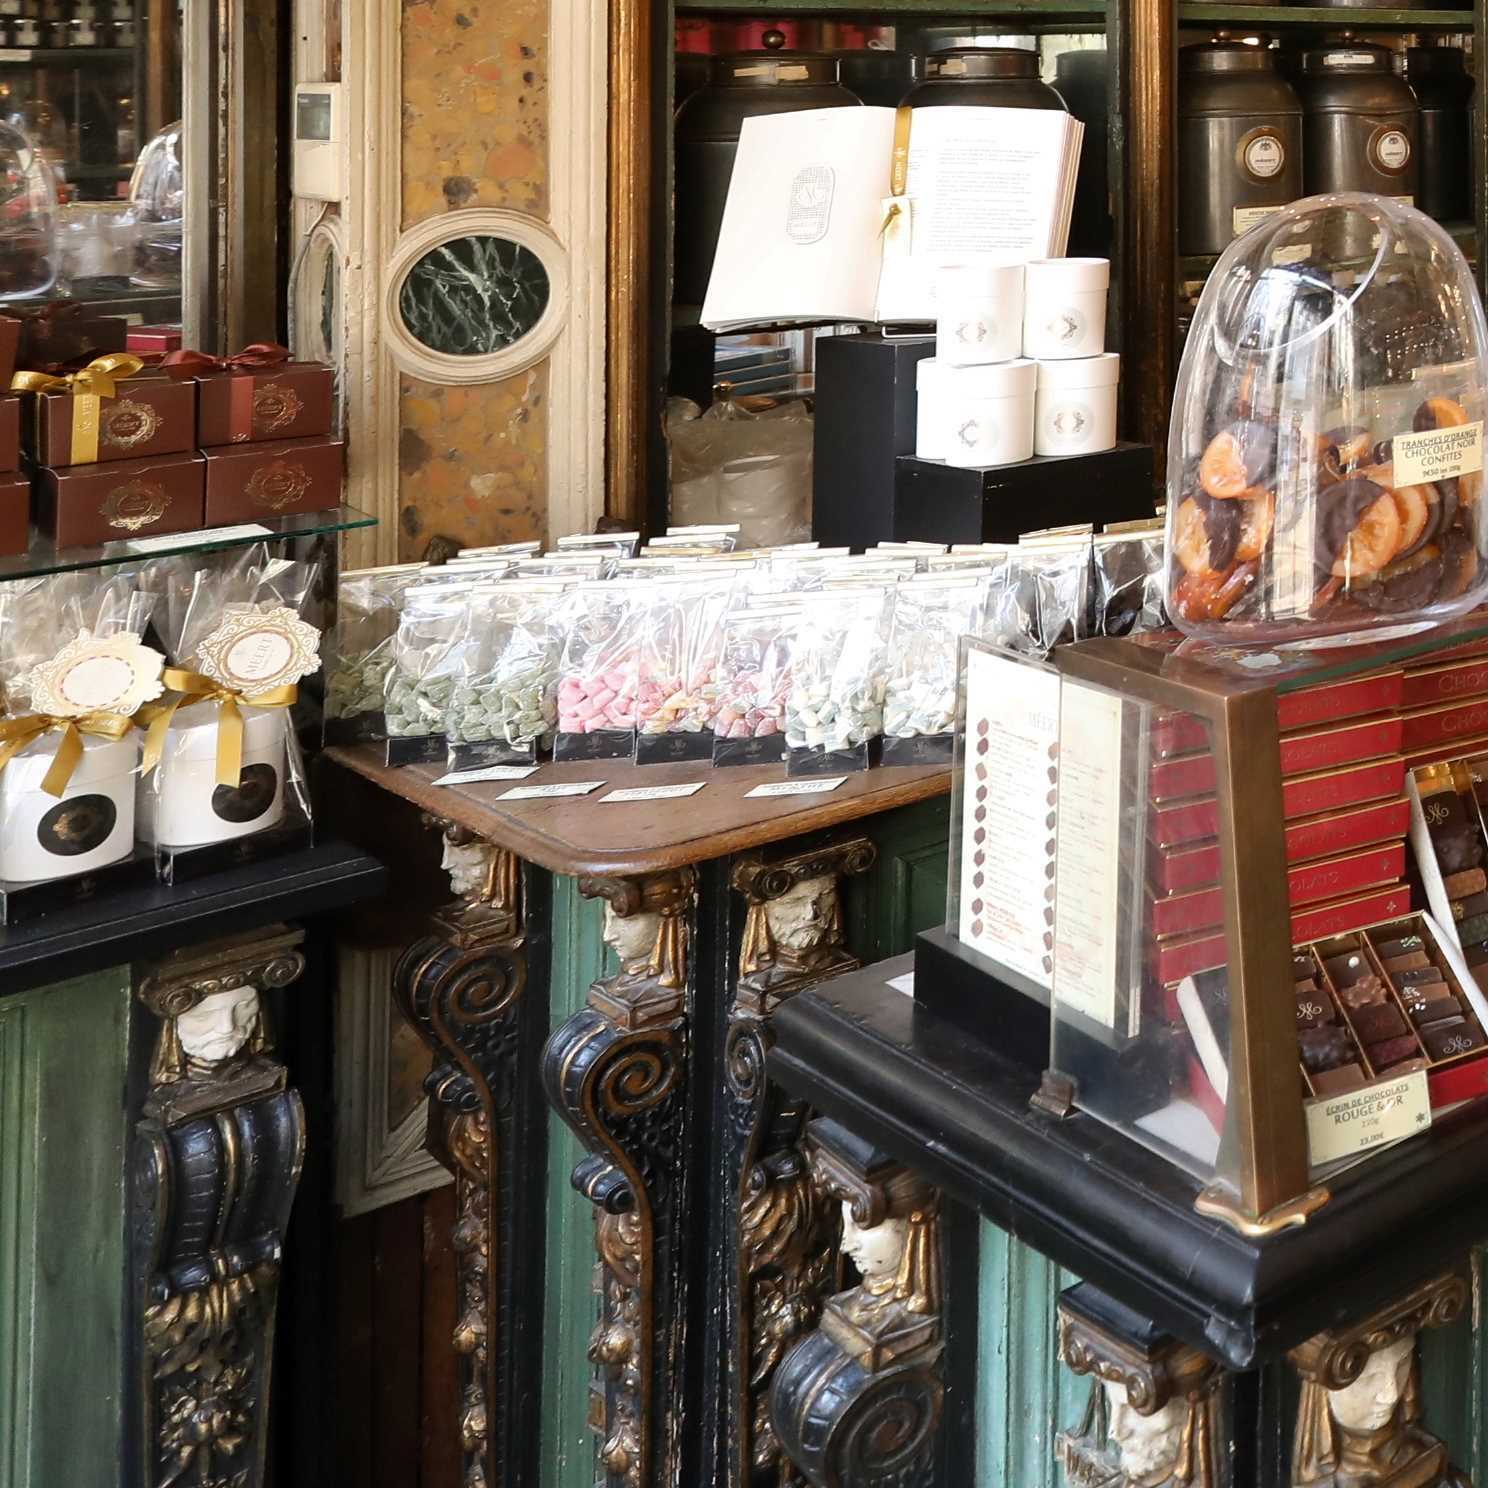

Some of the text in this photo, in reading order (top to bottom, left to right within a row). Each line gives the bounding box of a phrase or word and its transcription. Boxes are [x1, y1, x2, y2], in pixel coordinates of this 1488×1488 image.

[1401, 436, 1442, 450] TRANCHES
[1405, 438, 1476, 459] CHOCOLAT NOIR
[1421, 452, 1463, 466] CONFITES
[1326, 1083, 1409, 1116] ÉCRIN DE CHOCOLATS
[1334, 1104, 1375, 1125] ROUGE
[1376, 1101, 1385, 1112] &
